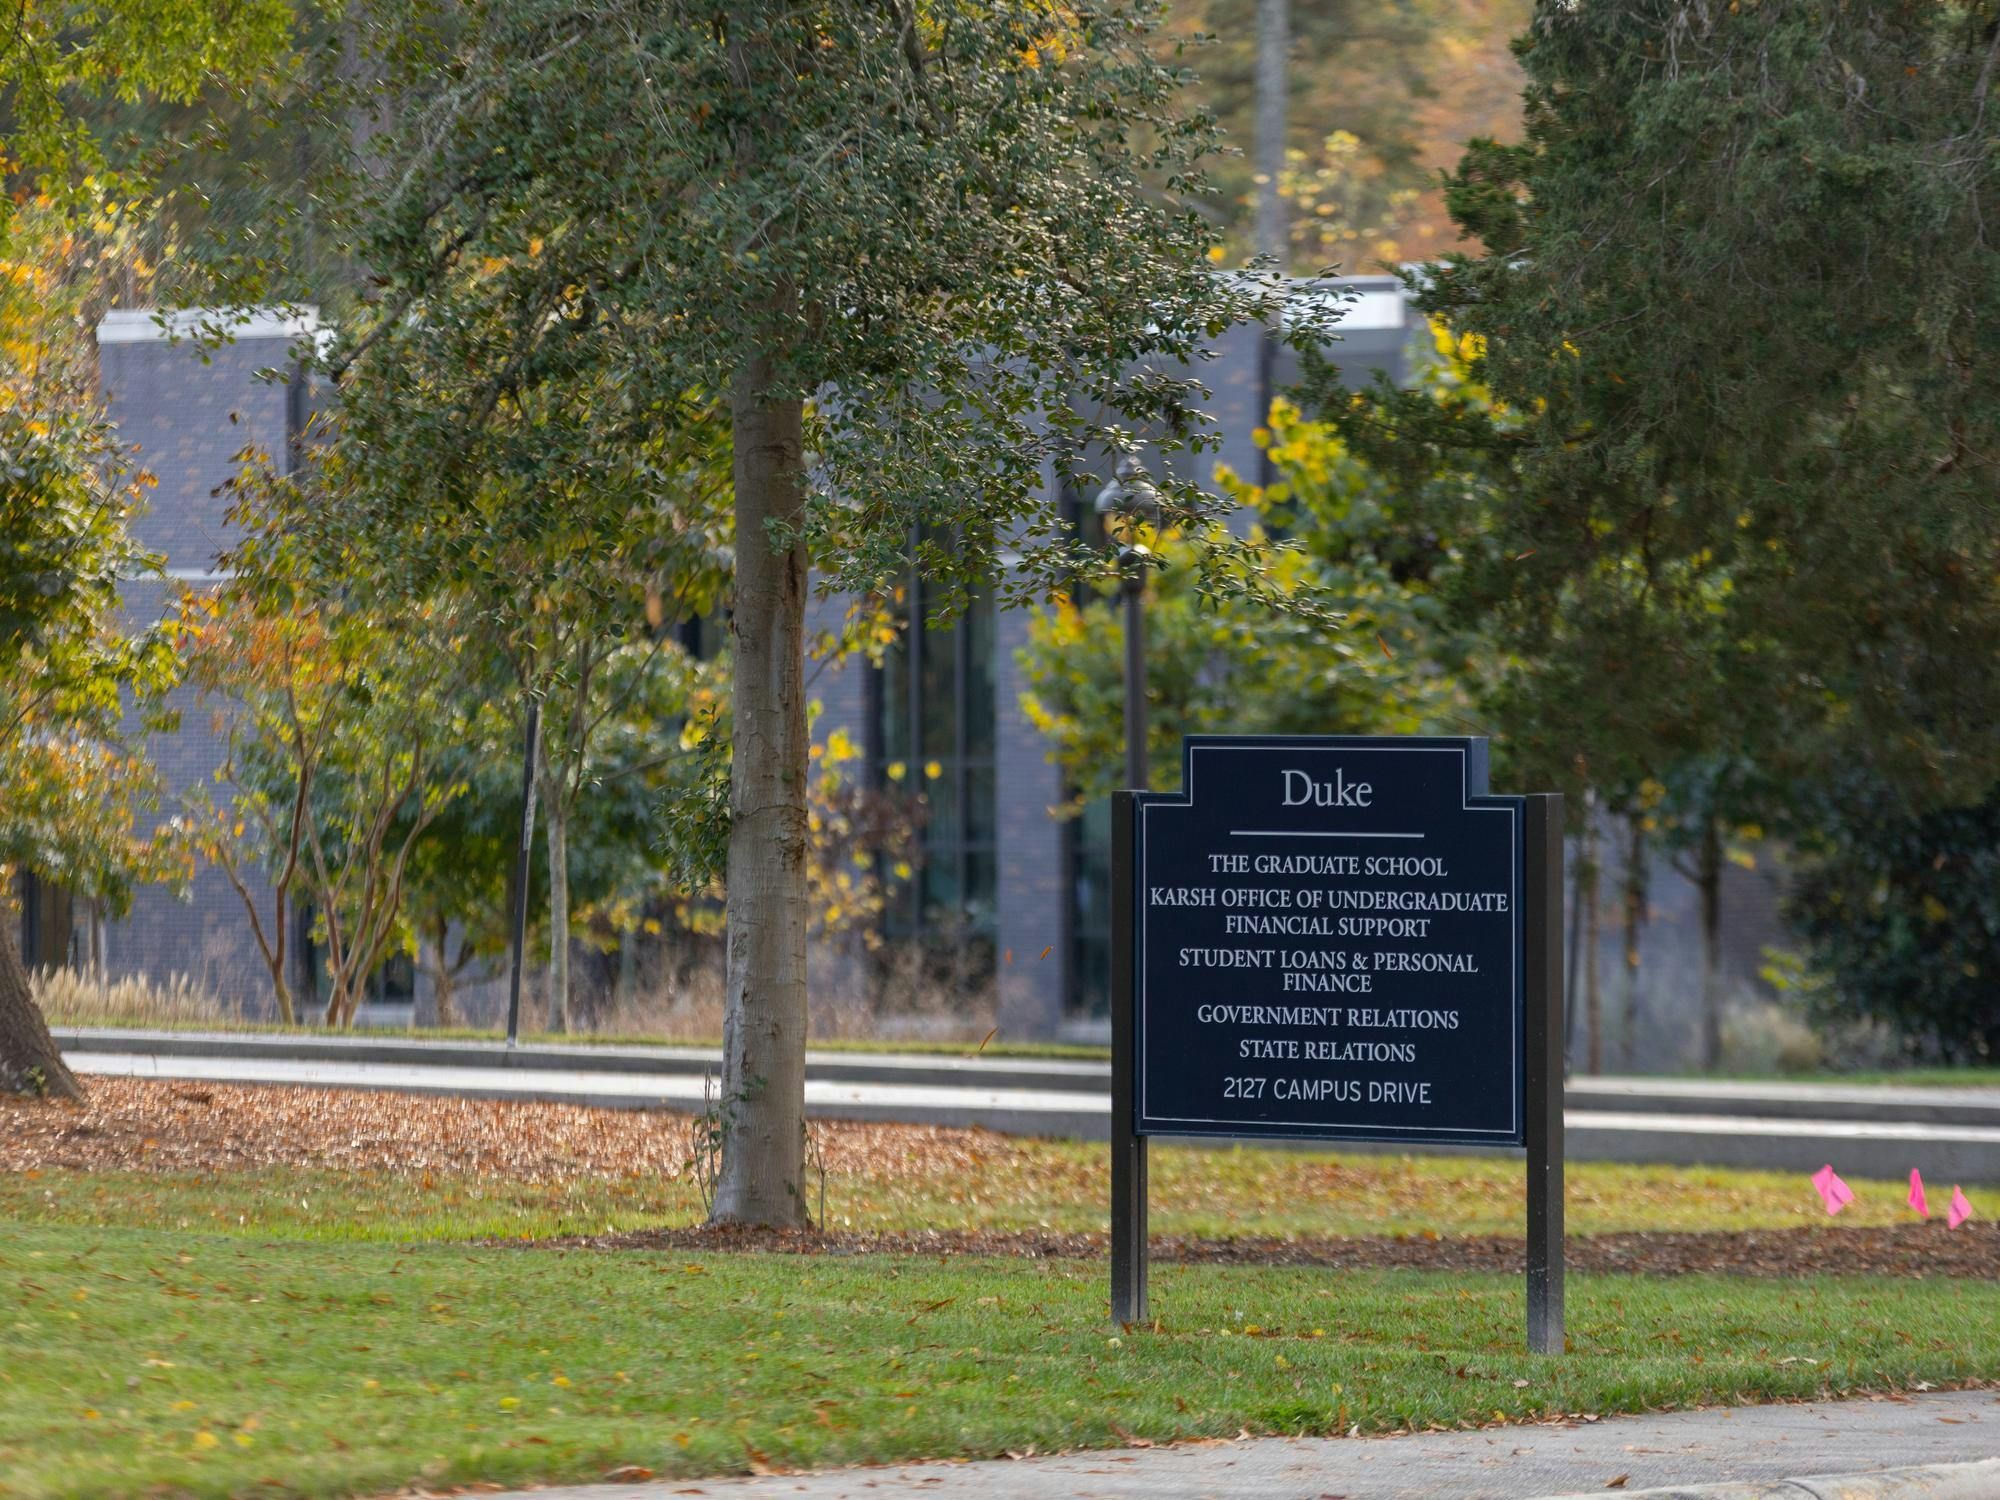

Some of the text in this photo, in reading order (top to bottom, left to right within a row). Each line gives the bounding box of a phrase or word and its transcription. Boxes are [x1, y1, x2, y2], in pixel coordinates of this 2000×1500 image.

[1281, 768, 1372, 806] Duke
[1208, 855, 1447, 876] THE GRADUATE SCHOOL
[1151, 888, 1508, 911] KARSH OFFICE OF UNDERGRADUATE
[1226, 916, 1430, 937] FINANCIAL SUPPORT
[1179, 948, 1478, 972] STUDENT LOANS & PERSONAL
[1283, 973, 1372, 992] FINANCE
[1198, 1005, 1458, 1029] GOVERNMENT RELATIONS
[1240, 1040, 1415, 1062] STATE RELATIONS
[1224, 1077, 1431, 1103] 2127 CAMPUS DRIVE
